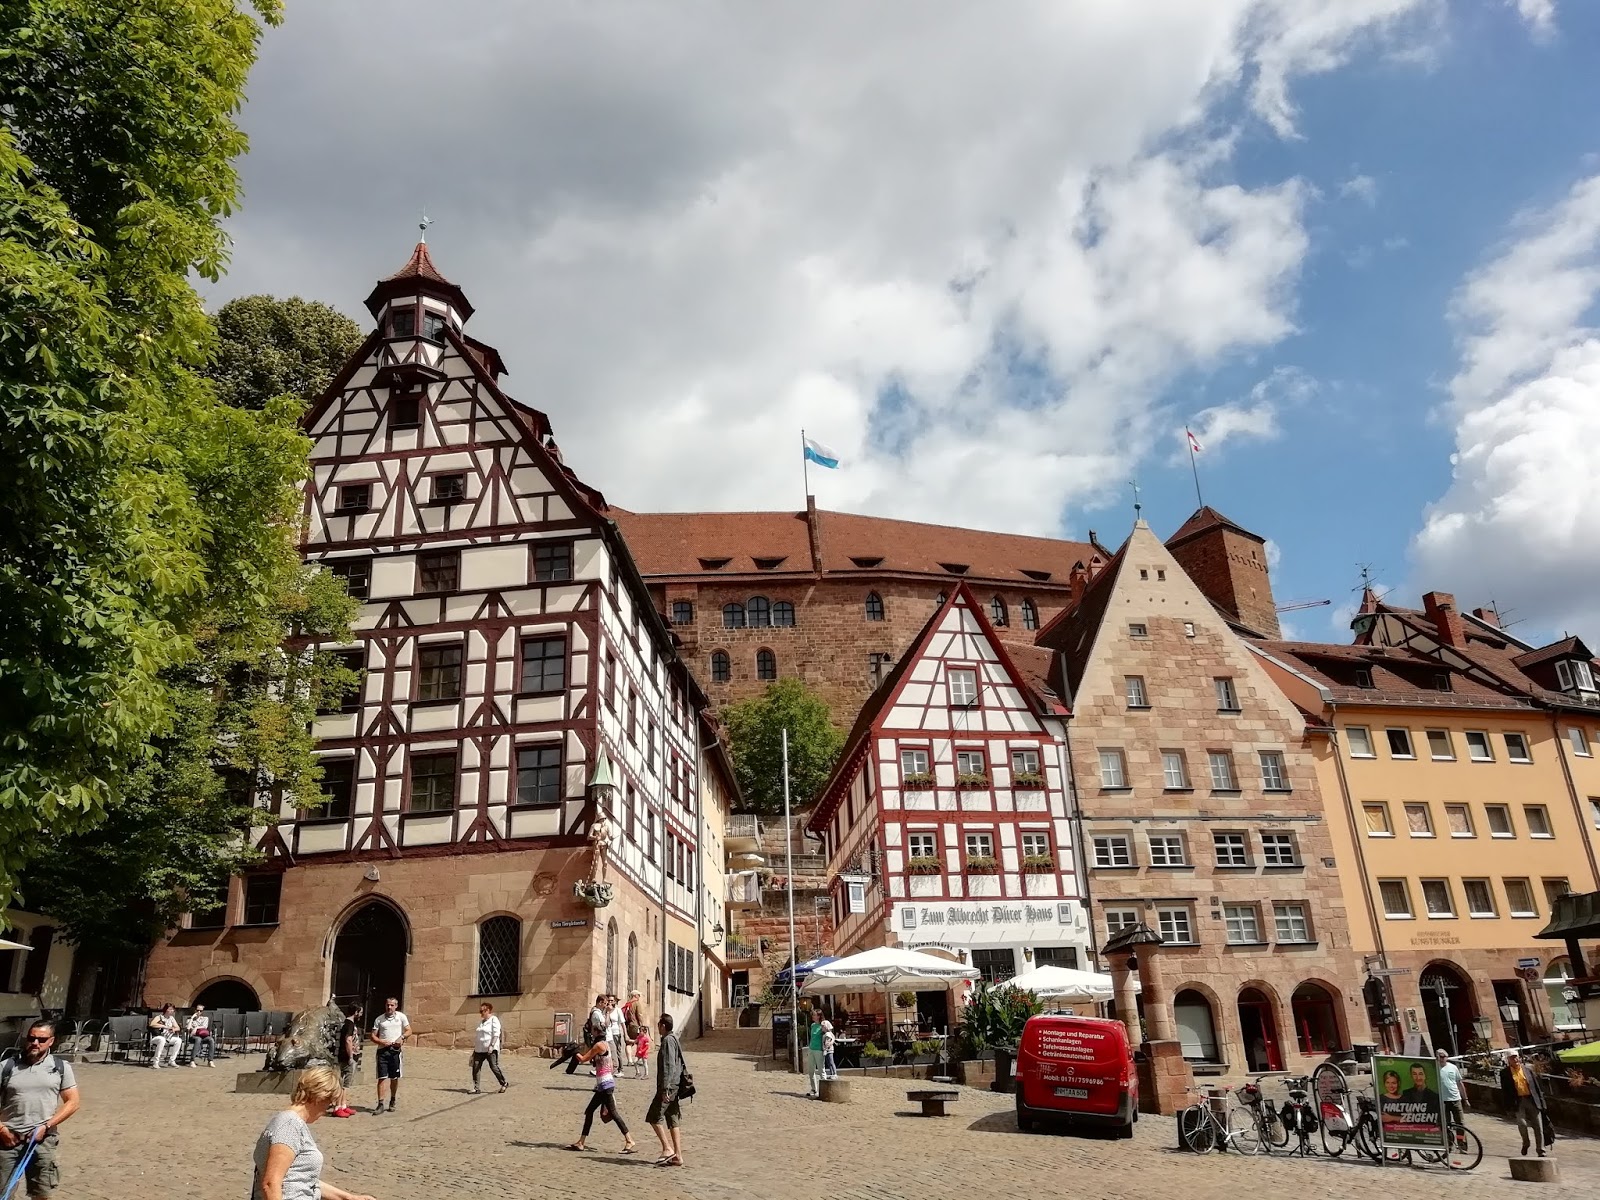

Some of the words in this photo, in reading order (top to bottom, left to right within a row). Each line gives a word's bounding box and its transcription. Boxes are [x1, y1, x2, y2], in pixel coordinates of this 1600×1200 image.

[920, 907, 945, 926] Zum
[946, 906, 990, 927] Albrecht
[991, 905, 1023, 925] Dürer
[1024, 904, 1053, 926] Haus
[1043, 1029, 1066, 1037] Montage
[1078, 1031, 1105, 1040] Reparatur
[1042, 1036, 1082, 1045] Schankanlagen
[1042, 1043, 1094, 1053] Tafelwasseranlagen
[1042, 1050, 1095, 1061] Getränkeautomaten
[1383, 1102, 1428, 1113] HALTUNG
[1400, 1112, 1439, 1123] ZEIGEN!
